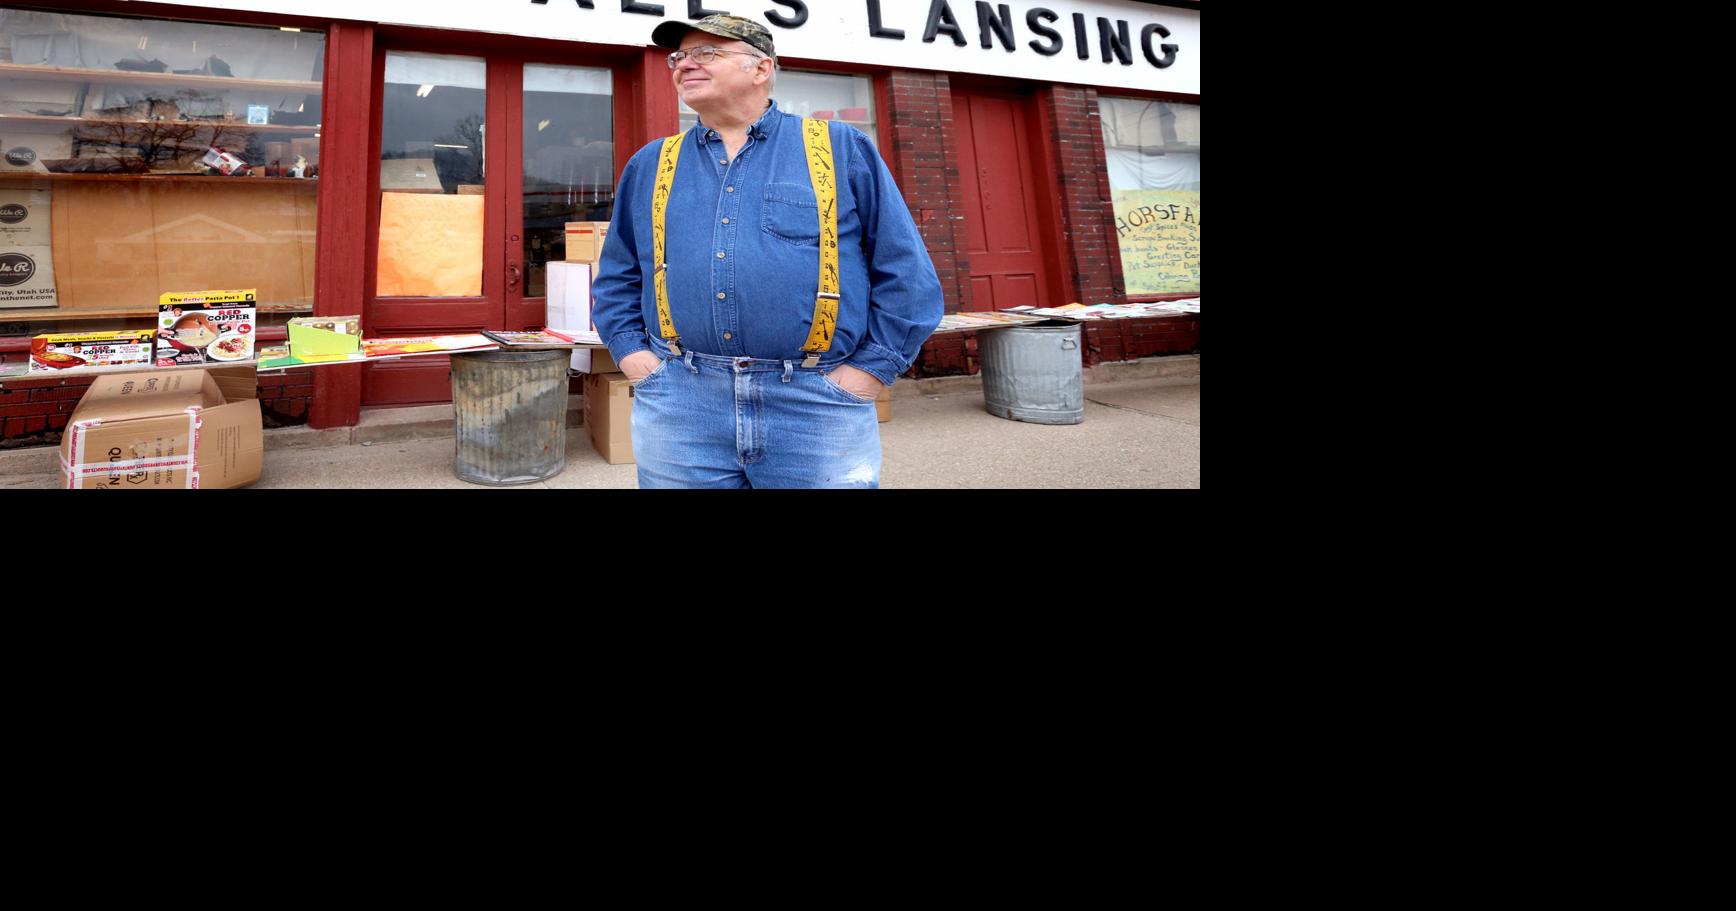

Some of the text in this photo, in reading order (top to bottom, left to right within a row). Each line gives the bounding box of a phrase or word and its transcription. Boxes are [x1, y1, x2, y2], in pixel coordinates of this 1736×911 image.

[866, 0, 1179, 69] LANSING
[1116, 203, 1200, 238] HORSFA
[207, 314, 250, 322] COPPER
[108, 446, 122, 486] QUN
